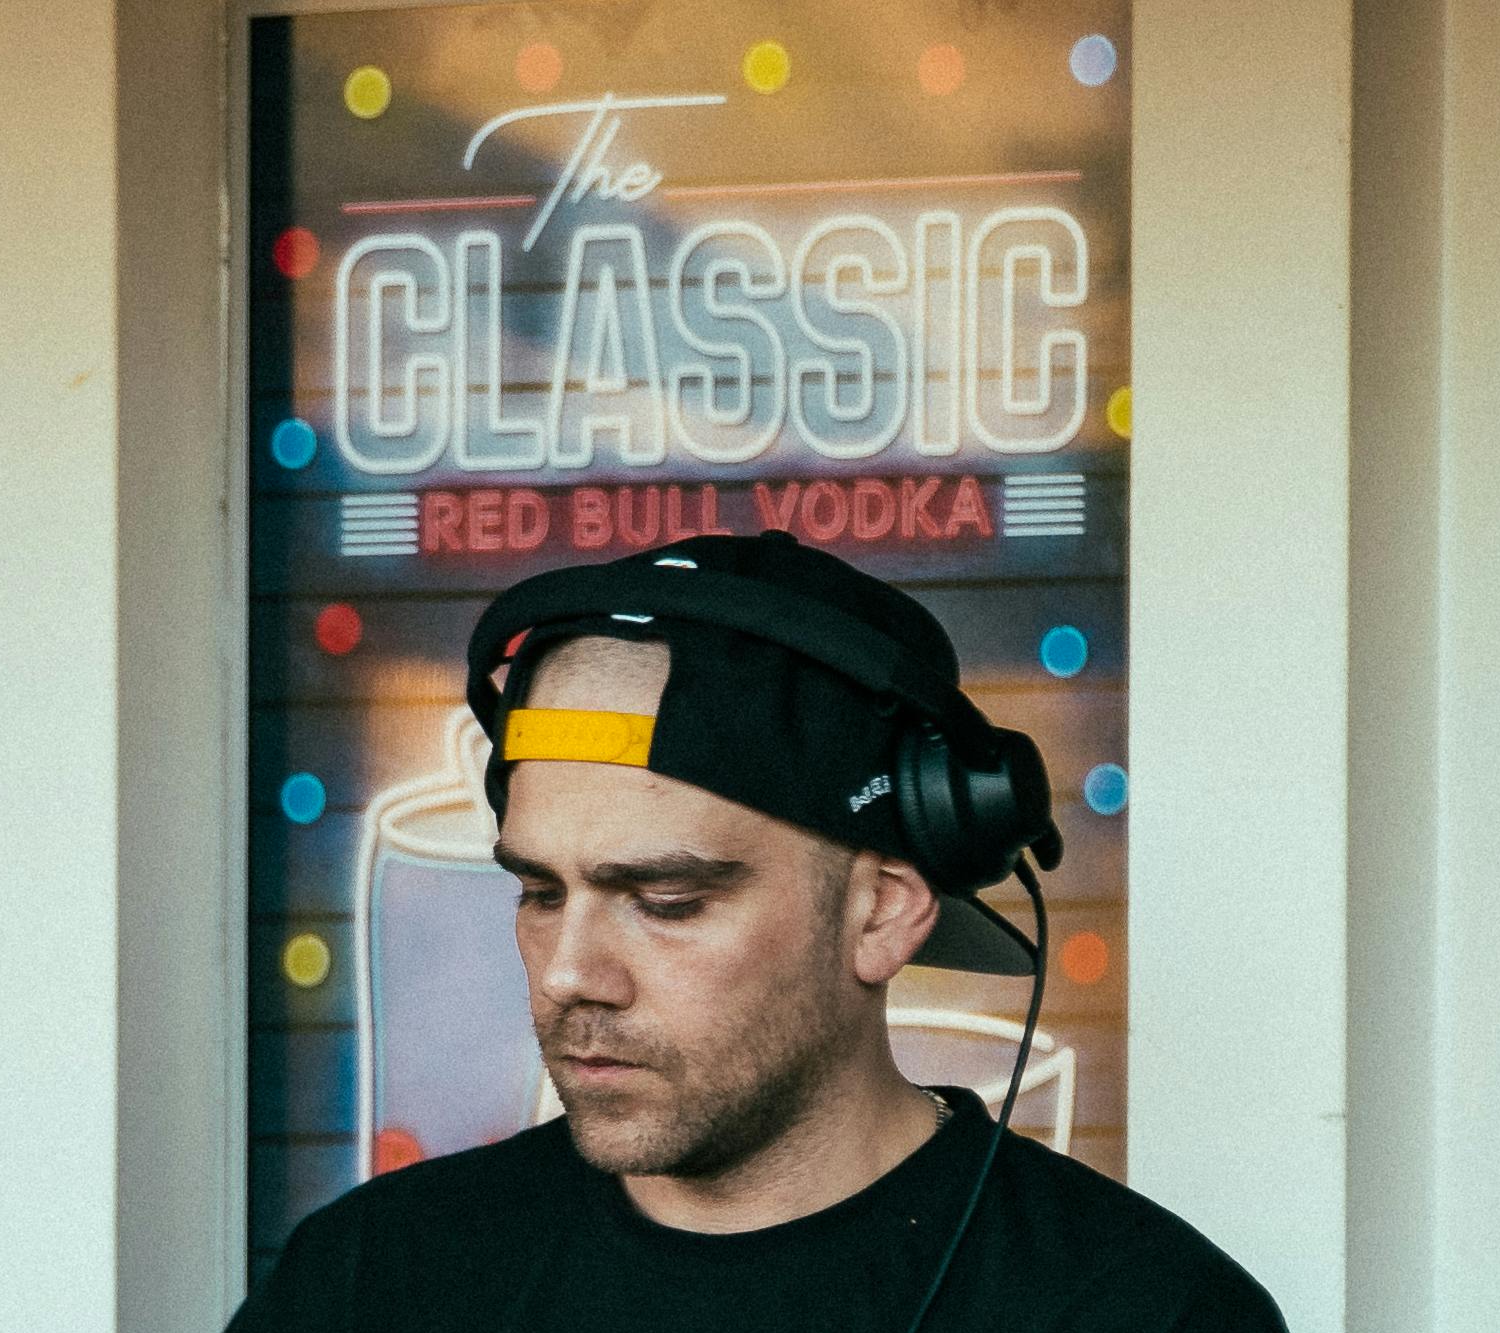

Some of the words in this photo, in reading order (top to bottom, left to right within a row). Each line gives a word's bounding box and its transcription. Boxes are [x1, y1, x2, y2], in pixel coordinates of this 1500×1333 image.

[463, 92, 727, 252] The
[335, 207, 1089, 475] CLASSIC
[422, 488, 550, 554] RED
[572, 484, 734, 548] BULL
[754, 475, 995, 542] VODKA
